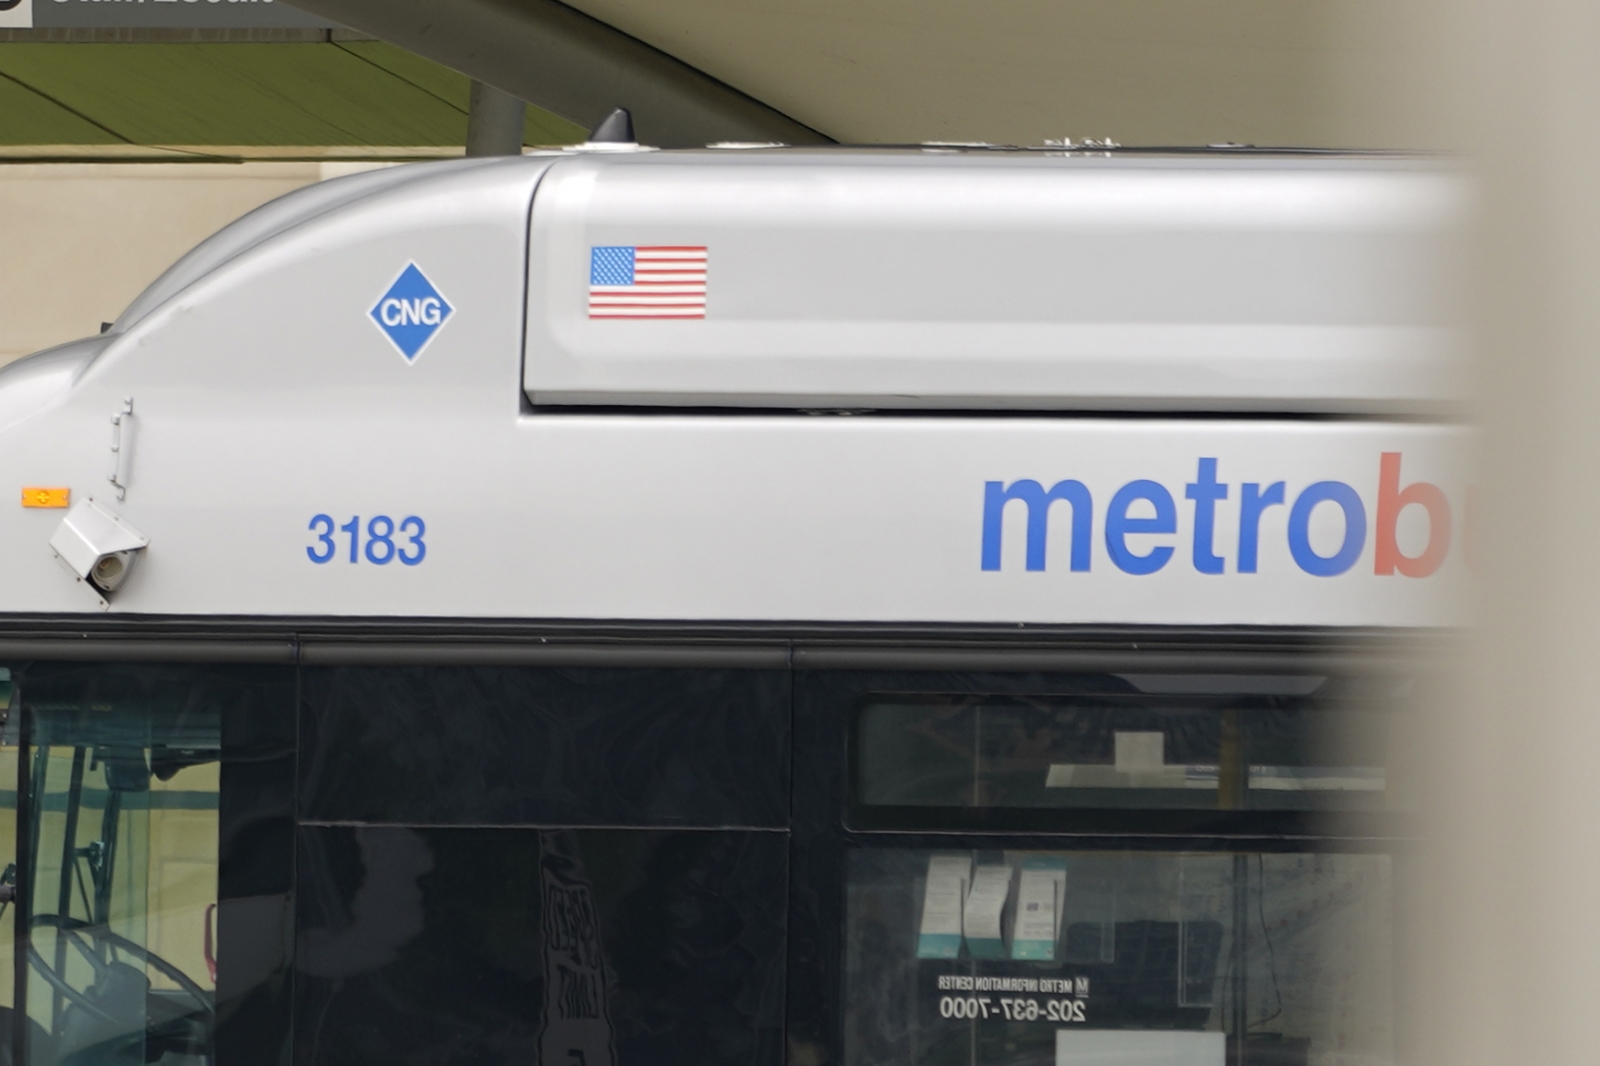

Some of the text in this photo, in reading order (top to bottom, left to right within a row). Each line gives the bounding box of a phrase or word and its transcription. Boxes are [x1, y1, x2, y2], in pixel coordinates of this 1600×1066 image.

[380, 297, 441, 327] CNG
[306, 513, 427, 567] 3183
[980, 451, 1455, 579] metrob
